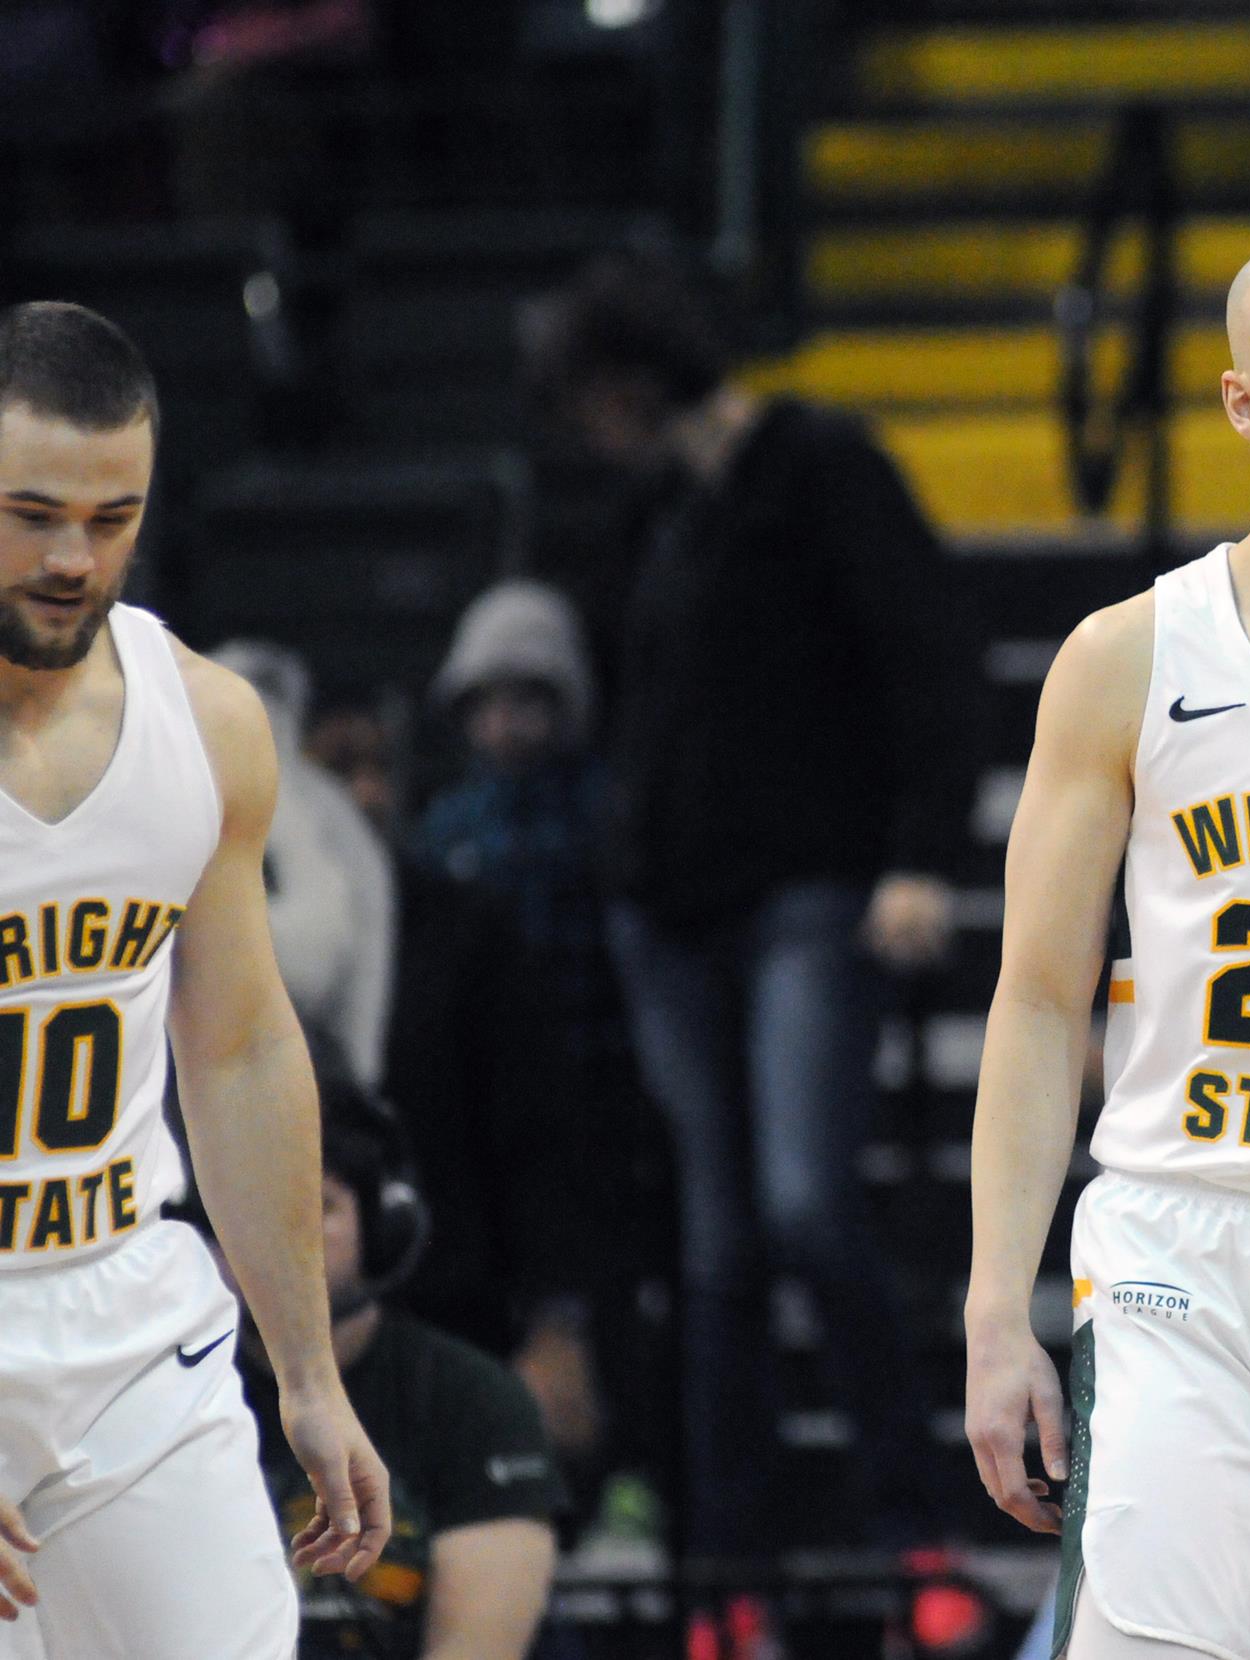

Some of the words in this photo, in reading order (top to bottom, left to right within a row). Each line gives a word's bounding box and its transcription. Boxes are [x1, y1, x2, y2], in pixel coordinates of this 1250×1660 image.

[0, 1155, 137, 1254] TATE
[1112, 1291, 1190, 1311] HORIZON
[1122, 1307, 1189, 1322] EAGUE
